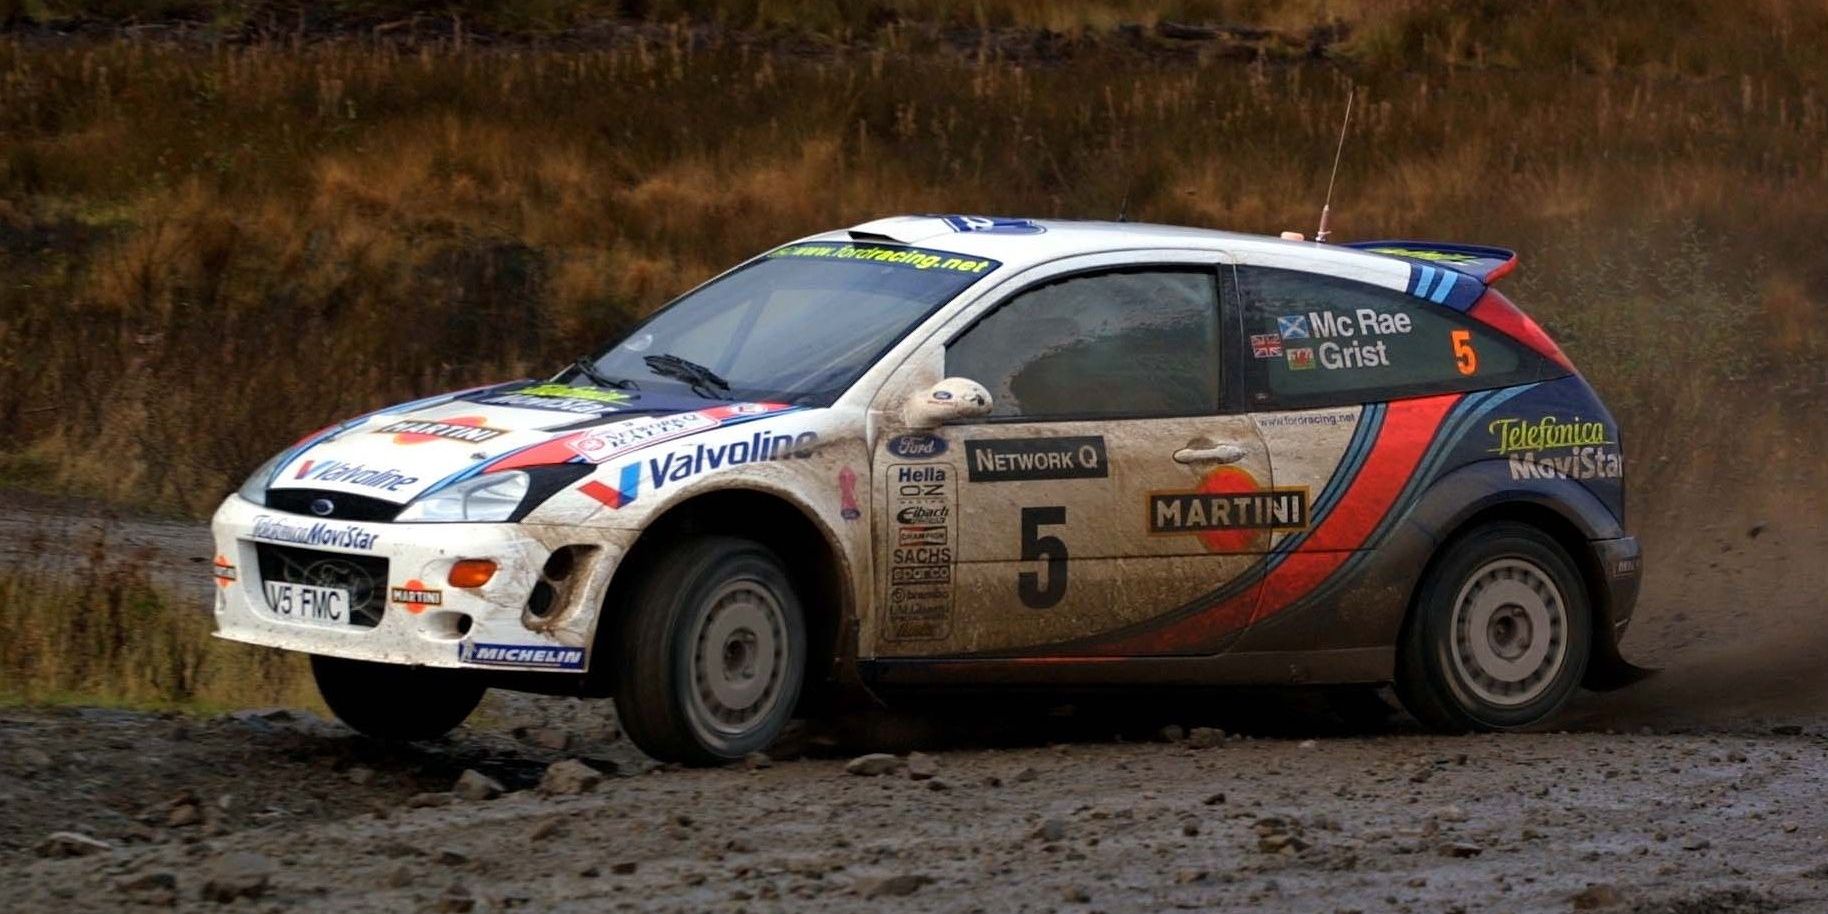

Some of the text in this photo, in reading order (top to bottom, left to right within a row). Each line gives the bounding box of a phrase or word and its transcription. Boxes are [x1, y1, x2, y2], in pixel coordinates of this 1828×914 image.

[1309, 308, 1412, 338] Mc Rae
[1319, 340, 1390, 370] Grist
[1451, 329, 1478, 376] 5
[385, 422, 499, 443] MARTINI
[898, 437, 936, 454] Ford
[649, 430, 819, 489] Valvoline
[1078, 444, 1098, 469] Q
[314, 461, 419, 492] Valvoline
[898, 467, 946, 482] Hella
[1157, 495, 1300, 528] MARTINI
[893, 548, 951, 564] SACHS
[1018, 506, 1069, 609] 5
[267, 583, 341, 620] V5 FMC
[393, 589, 440, 603] MARTINI
[477, 647, 582, 664] MICHELIN
